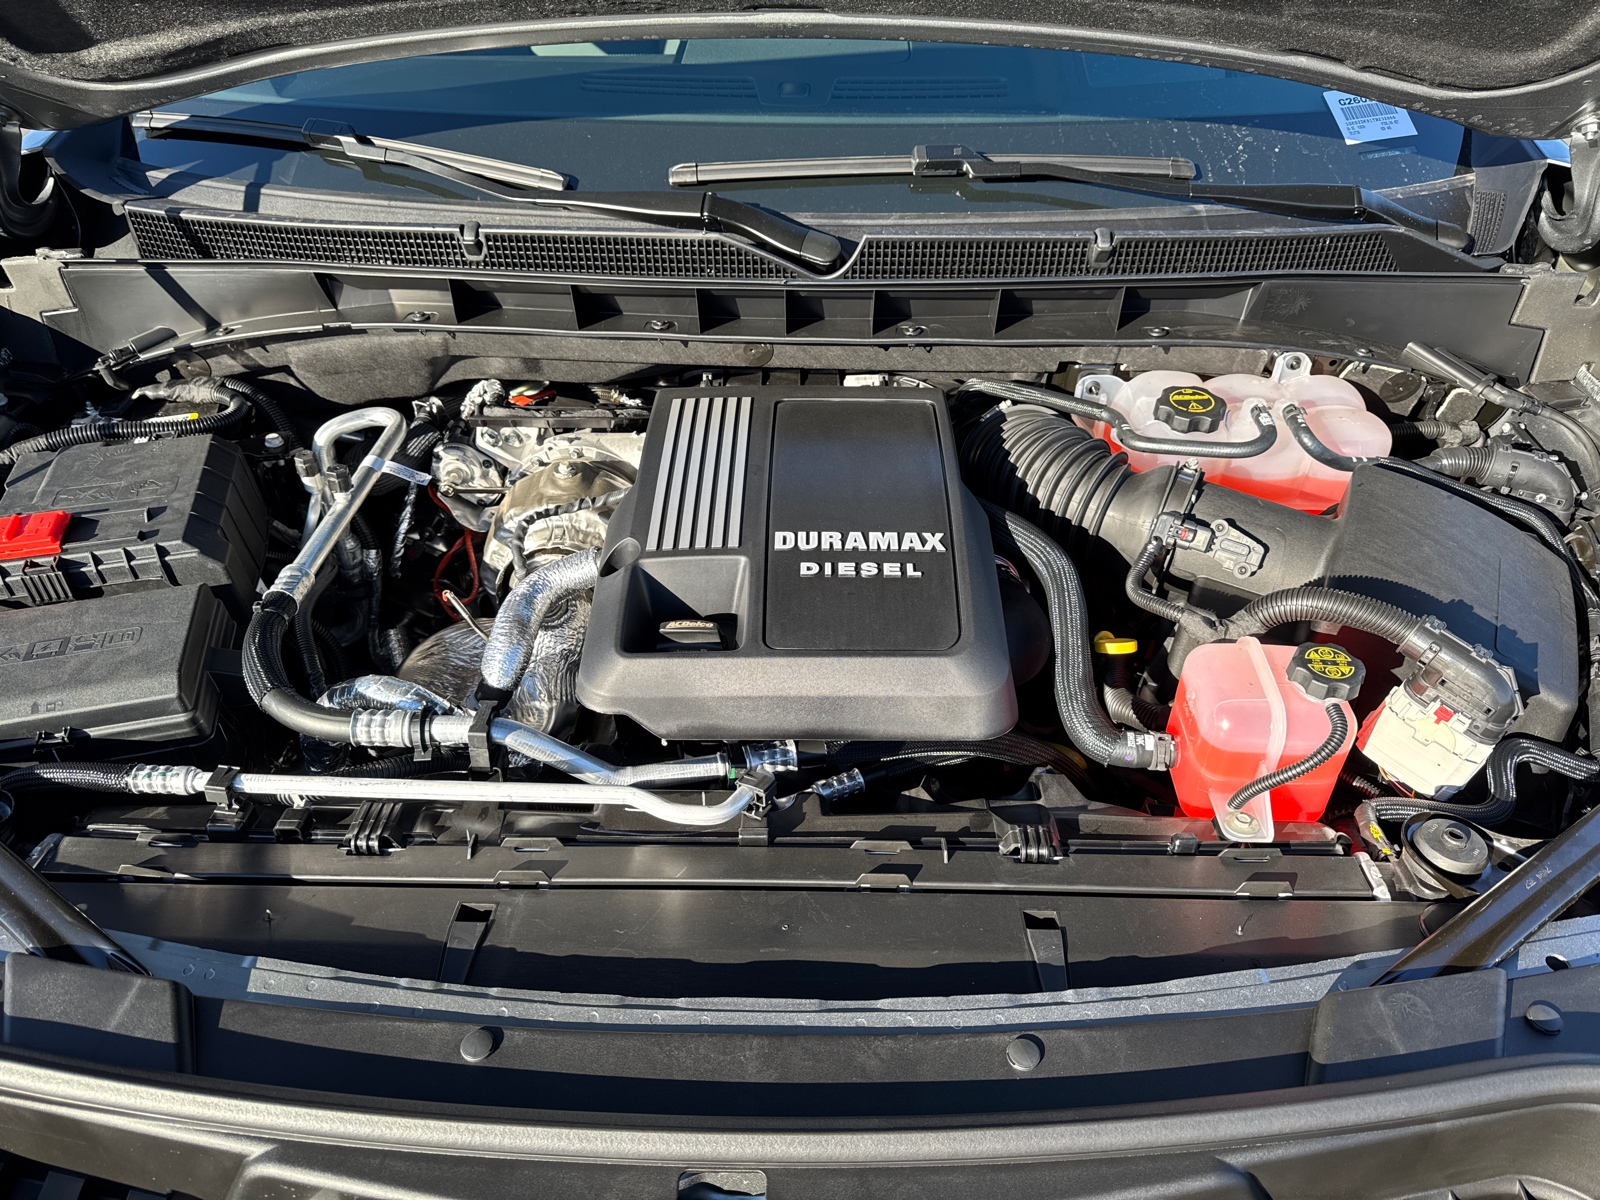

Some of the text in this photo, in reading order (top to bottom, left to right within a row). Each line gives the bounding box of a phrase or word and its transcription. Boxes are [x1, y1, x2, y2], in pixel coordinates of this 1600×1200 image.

[1338, 97, 1374, 106] G260
[774, 531, 946, 552] DURAMAX
[800, 562, 922, 579] DIESEL
[665, 621, 714, 629] ACDelco
